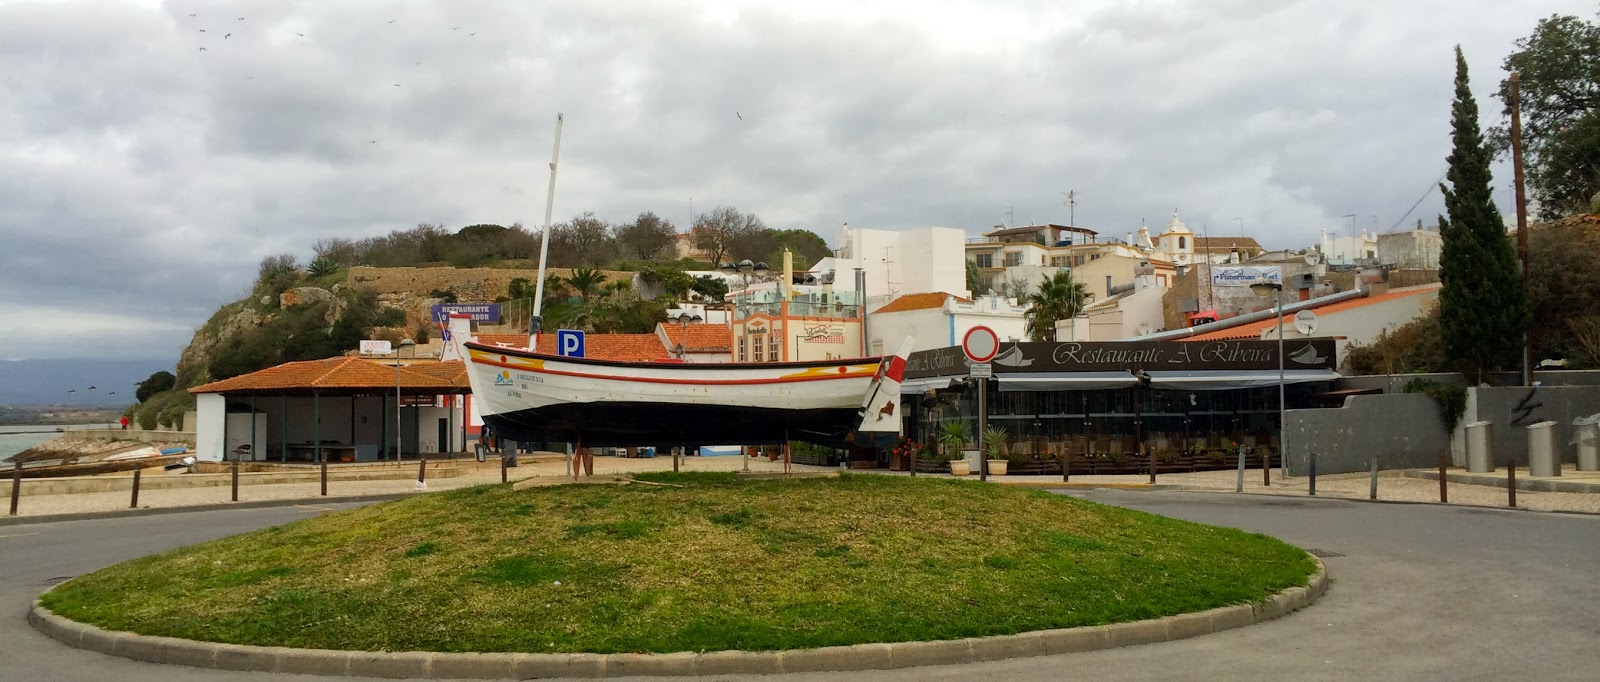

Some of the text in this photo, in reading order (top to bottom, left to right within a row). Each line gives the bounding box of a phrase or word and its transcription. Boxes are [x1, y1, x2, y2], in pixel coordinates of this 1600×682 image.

[563, 333, 579, 357] P
[1052, 341, 1274, 365] Restaurante A Ribeira
